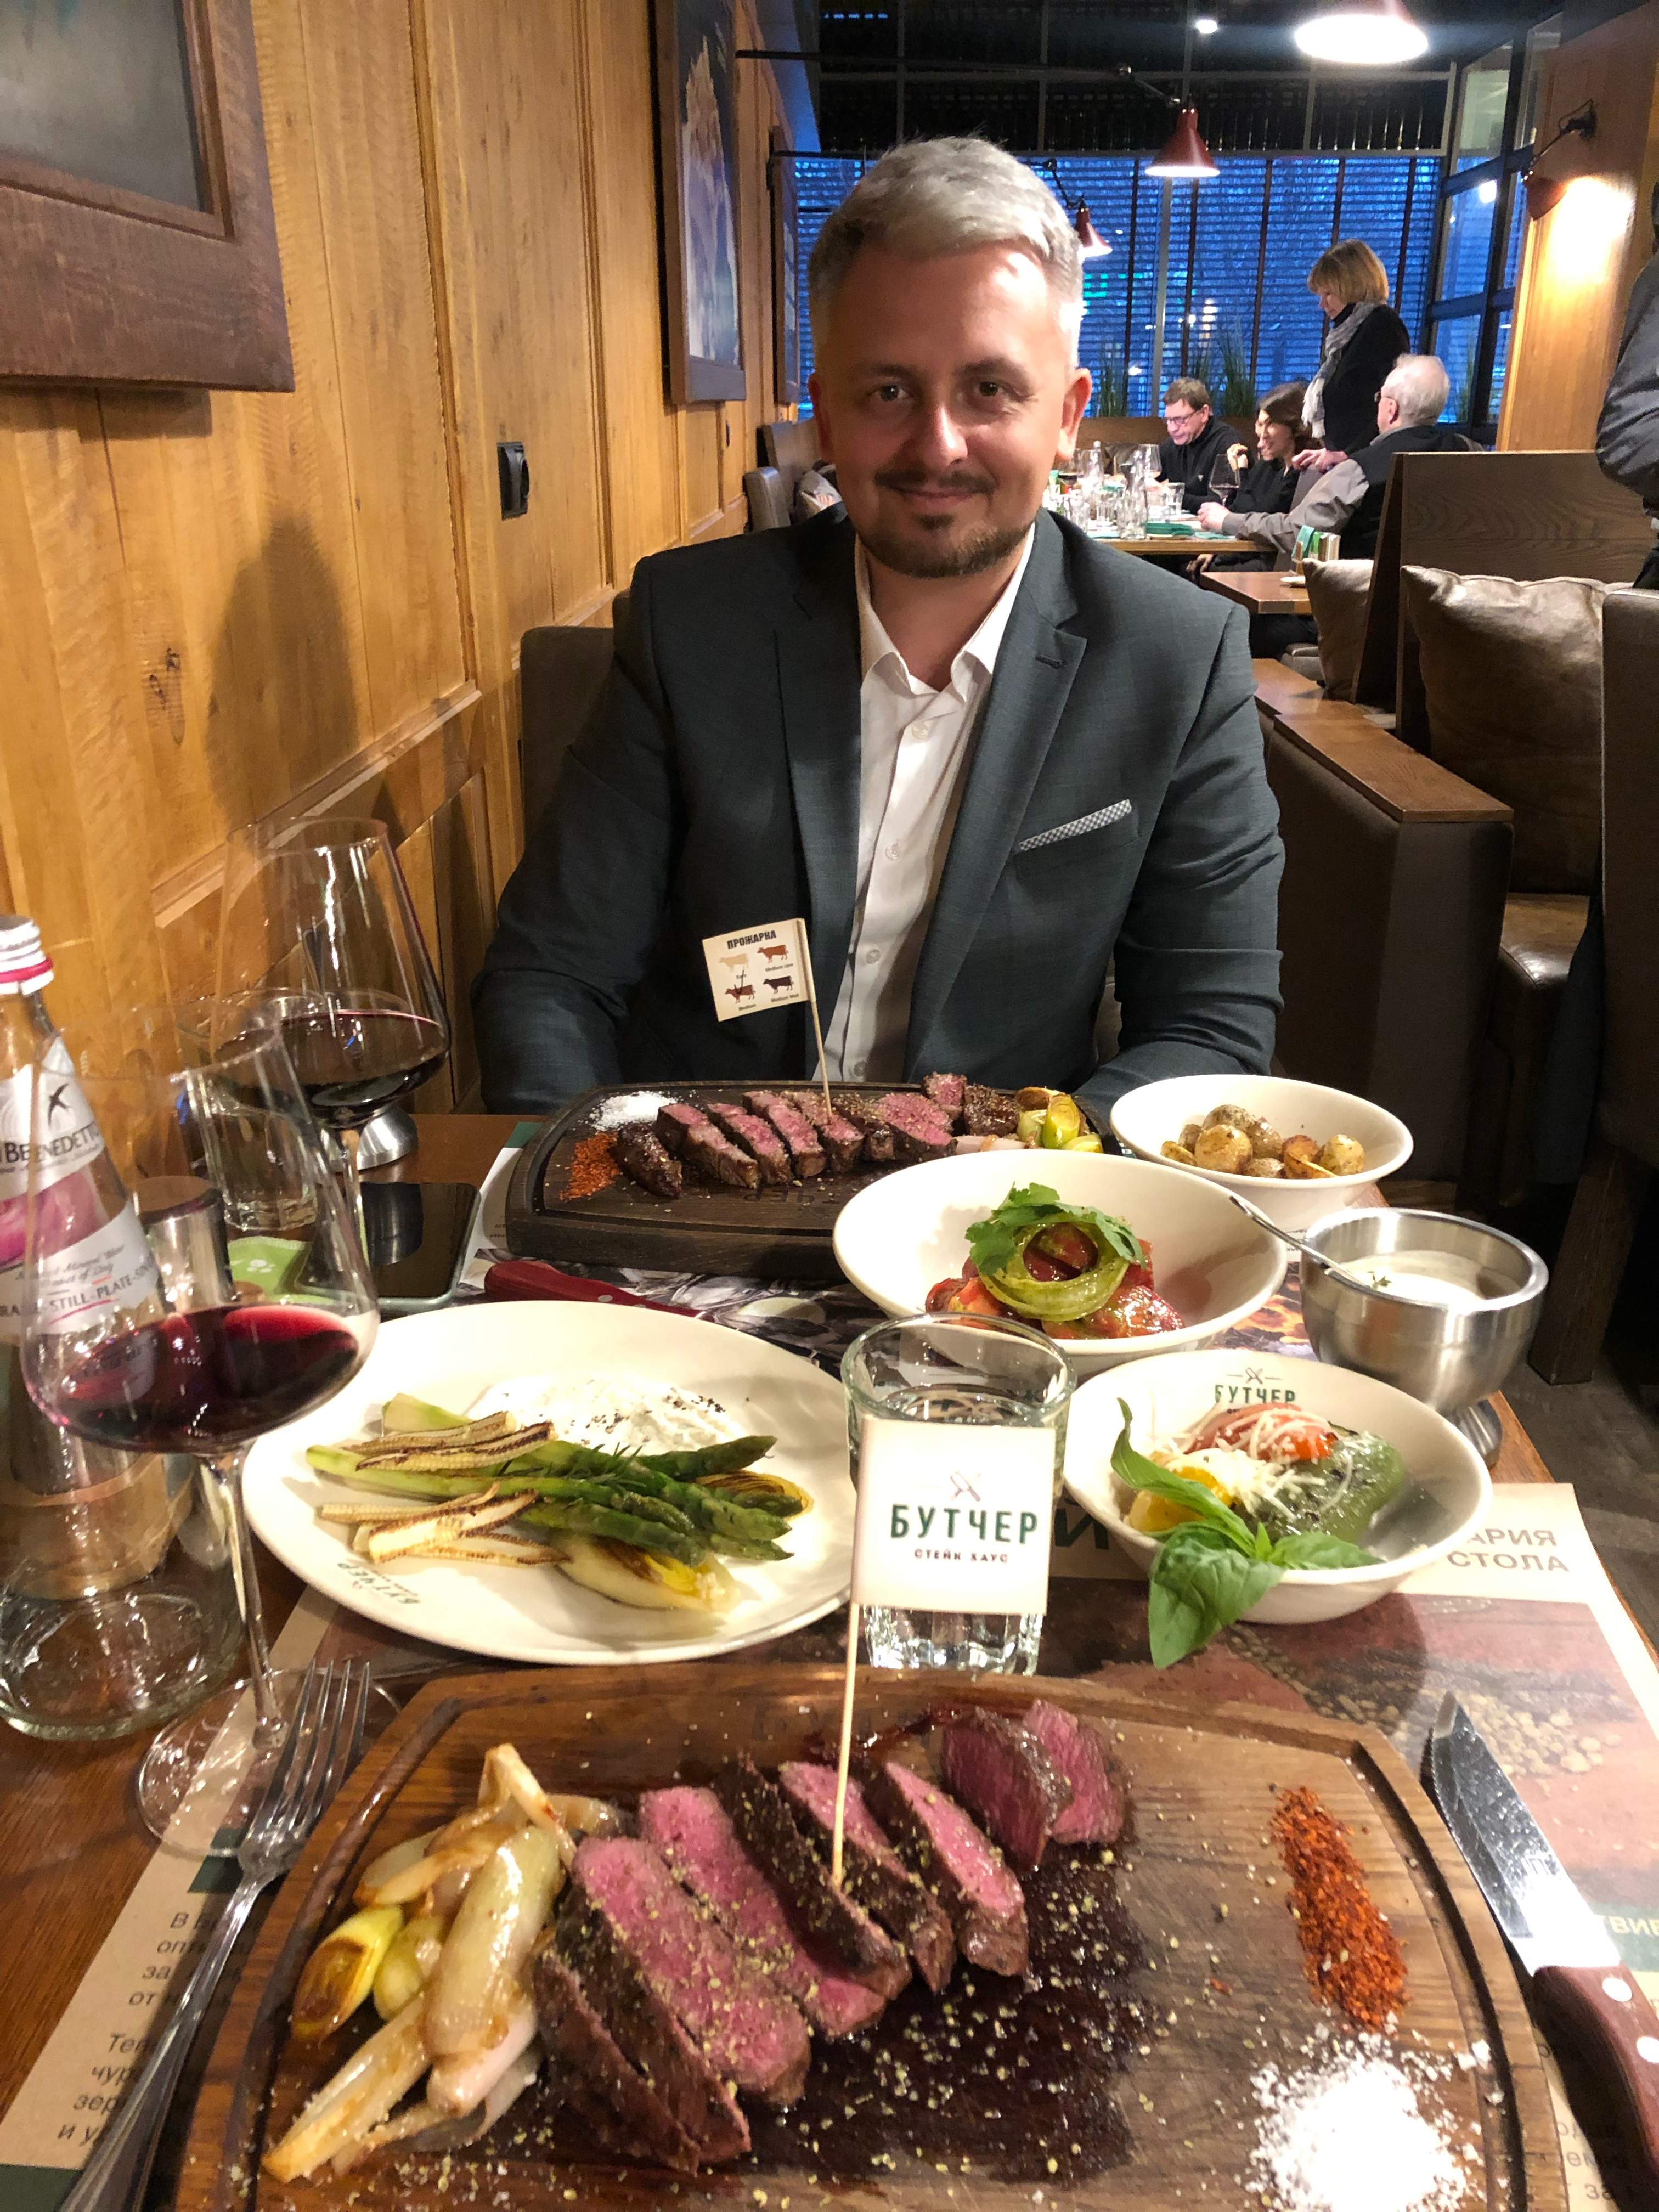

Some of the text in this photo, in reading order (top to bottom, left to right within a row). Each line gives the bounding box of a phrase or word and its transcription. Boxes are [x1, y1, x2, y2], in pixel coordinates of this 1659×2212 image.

[890, 1503, 1038, 1545] БУТЧЕР
[914, 1547, 1008, 1564] СТЕЙК ХАУС
[1447, 1550, 1570, 1572] СТОЛА
